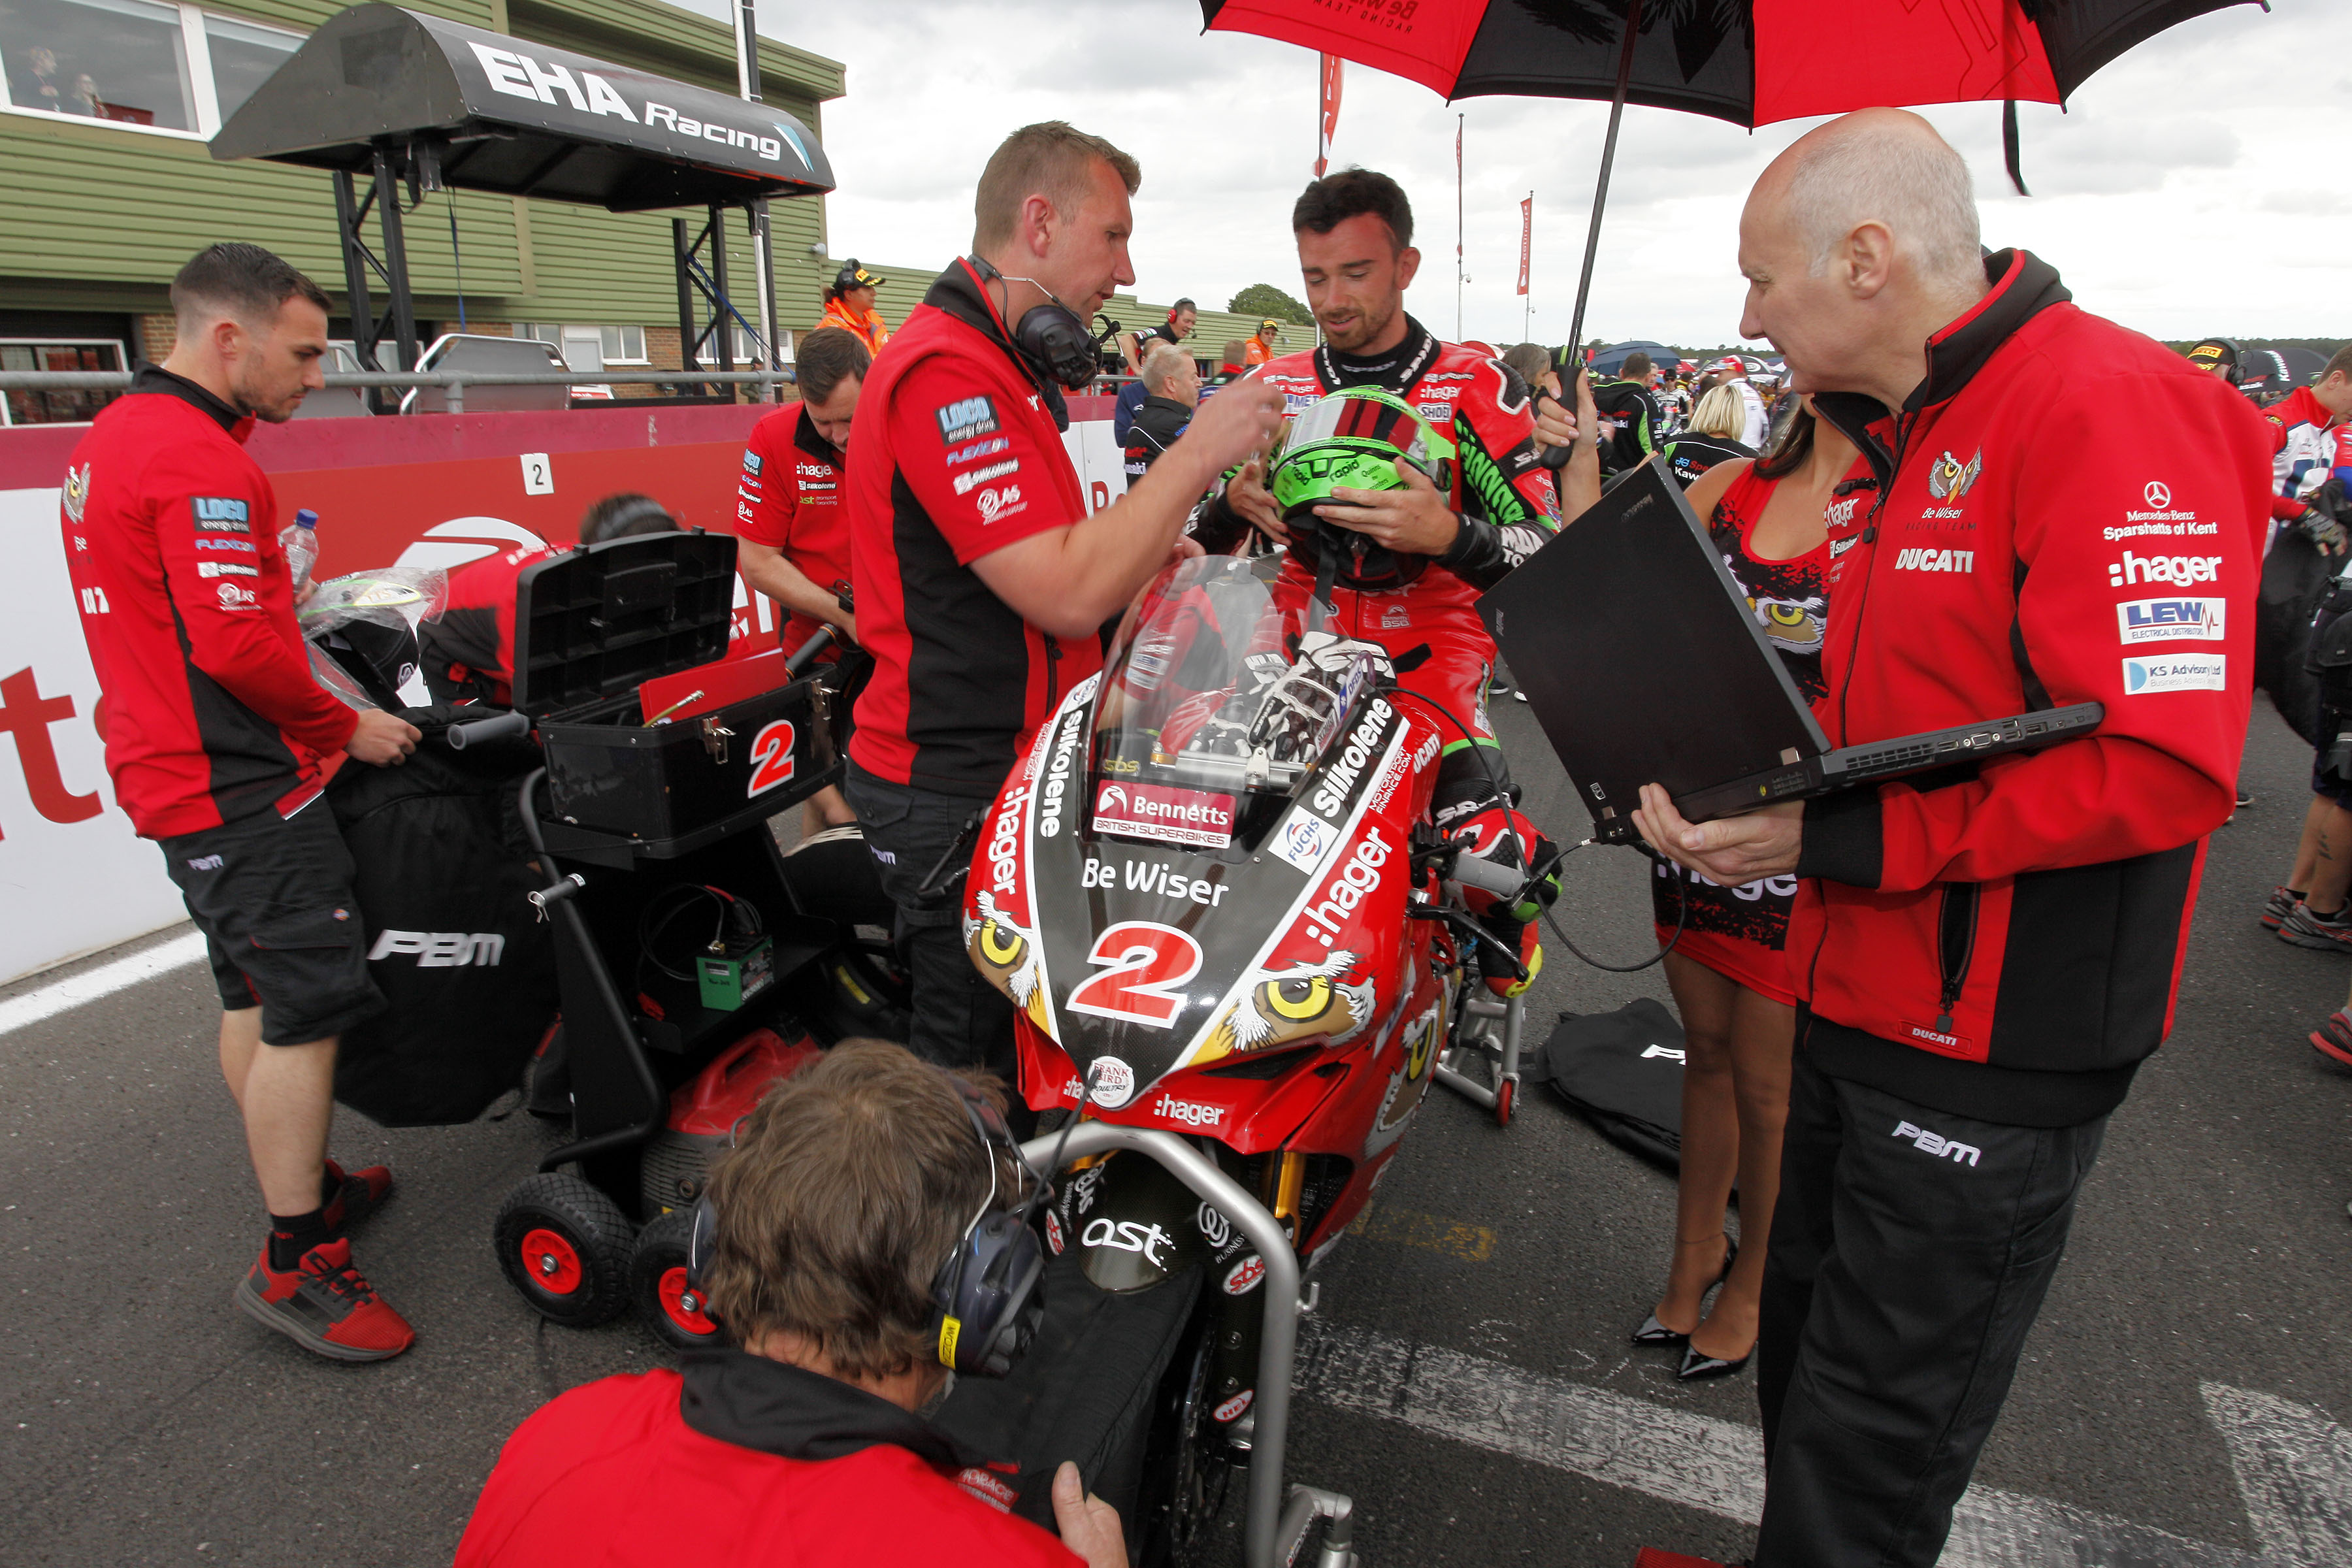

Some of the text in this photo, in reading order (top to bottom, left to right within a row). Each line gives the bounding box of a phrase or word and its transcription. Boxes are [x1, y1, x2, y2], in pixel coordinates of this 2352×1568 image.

[467, 41, 781, 161] EHA Racing
[939, 397, 990, 433] LOCO
[533, 463, 544, 486] 2
[796, 462, 833, 478] :hage
[1329, 459, 1360, 482] rapid
[1674, 466, 1699, 481] Kaw
[1921, 507, 1963, 519] Be Wiser
[2127, 510, 2195, 522] Mercedes-Benz
[2103, 522, 2218, 542] Sparshatts of Kent
[1895, 547, 1974, 573] DUCATI
[2108, 550, 2222, 587] :hager
[2127, 601, 2203, 626] LEW
[2132, 629, 2171, 639] ELECTRICAL
[1347, 666, 1362, 696] DFDS
[2149, 666, 2167, 677] KS
[2171, 664, 2210, 678] Advisory
[747, 719, 795, 798] 2
[1369, 745, 1407, 811] MOTORSPORT
[1375, 753, 1413, 815] FINANCE.COM
[1133, 795, 1229, 826] Bennetts
[988, 786, 1030, 895] :hager
[1096, 820, 1225, 845] BRITISH SUPERBIKES
[1287, 818, 1320, 862] FUCHS
[1082, 858, 1230, 907] Be Wiser
[1303, 826, 1393, 947] :hager
[1065, 921, 1203, 1030] 2
[1912, 1027, 1957, 1047] DUCATI
[1094, 1063, 1129, 1077] FRANK
[1154, 1094, 1224, 1126] :hager
[1214, 1233, 1246, 1264] BUSINESS
